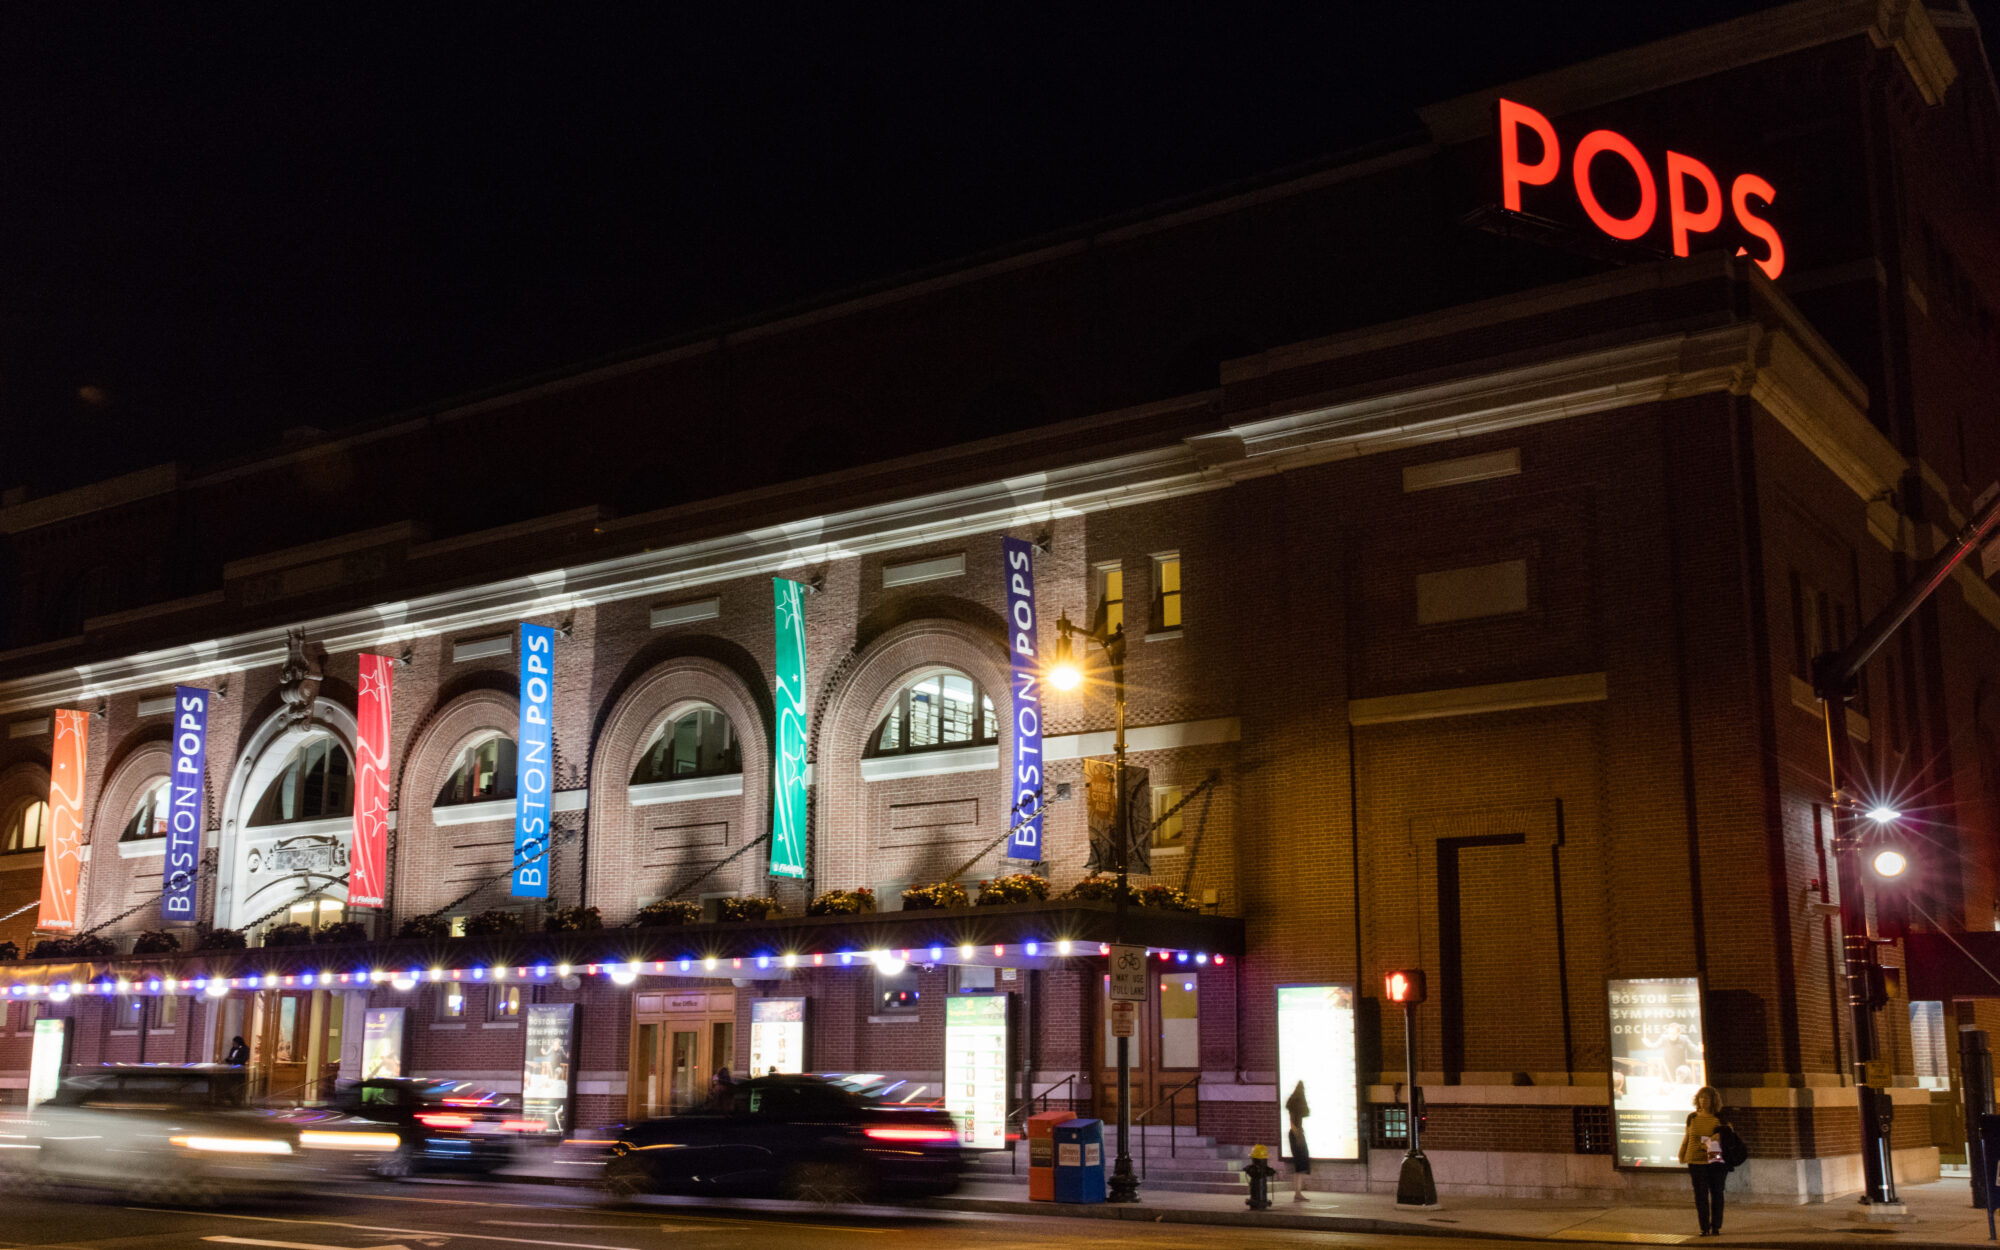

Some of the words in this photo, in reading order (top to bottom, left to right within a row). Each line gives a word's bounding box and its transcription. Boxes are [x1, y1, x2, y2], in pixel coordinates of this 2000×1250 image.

[1500, 98, 1785, 281] POPS
[1009, 550, 1035, 657] POPS
[526, 635, 549, 726] POPS
[177, 696, 204, 775] POPS
[1015, 673, 1039, 847] BOSTON
[168, 786, 197, 912] BOSTON
[519, 740, 546, 886] BOSTON
[1112, 985, 1129, 995] FULL
[1130, 985, 1145, 996] LANE
[1115, 974, 1129, 982] MAY
[1132, 975, 1144, 984] USE
[1611, 993, 1668, 1004] BOSTON
[1612, 1008, 1697, 1020] SYMPHONY
[1613, 1024, 1698, 1035] ORCHESRA
